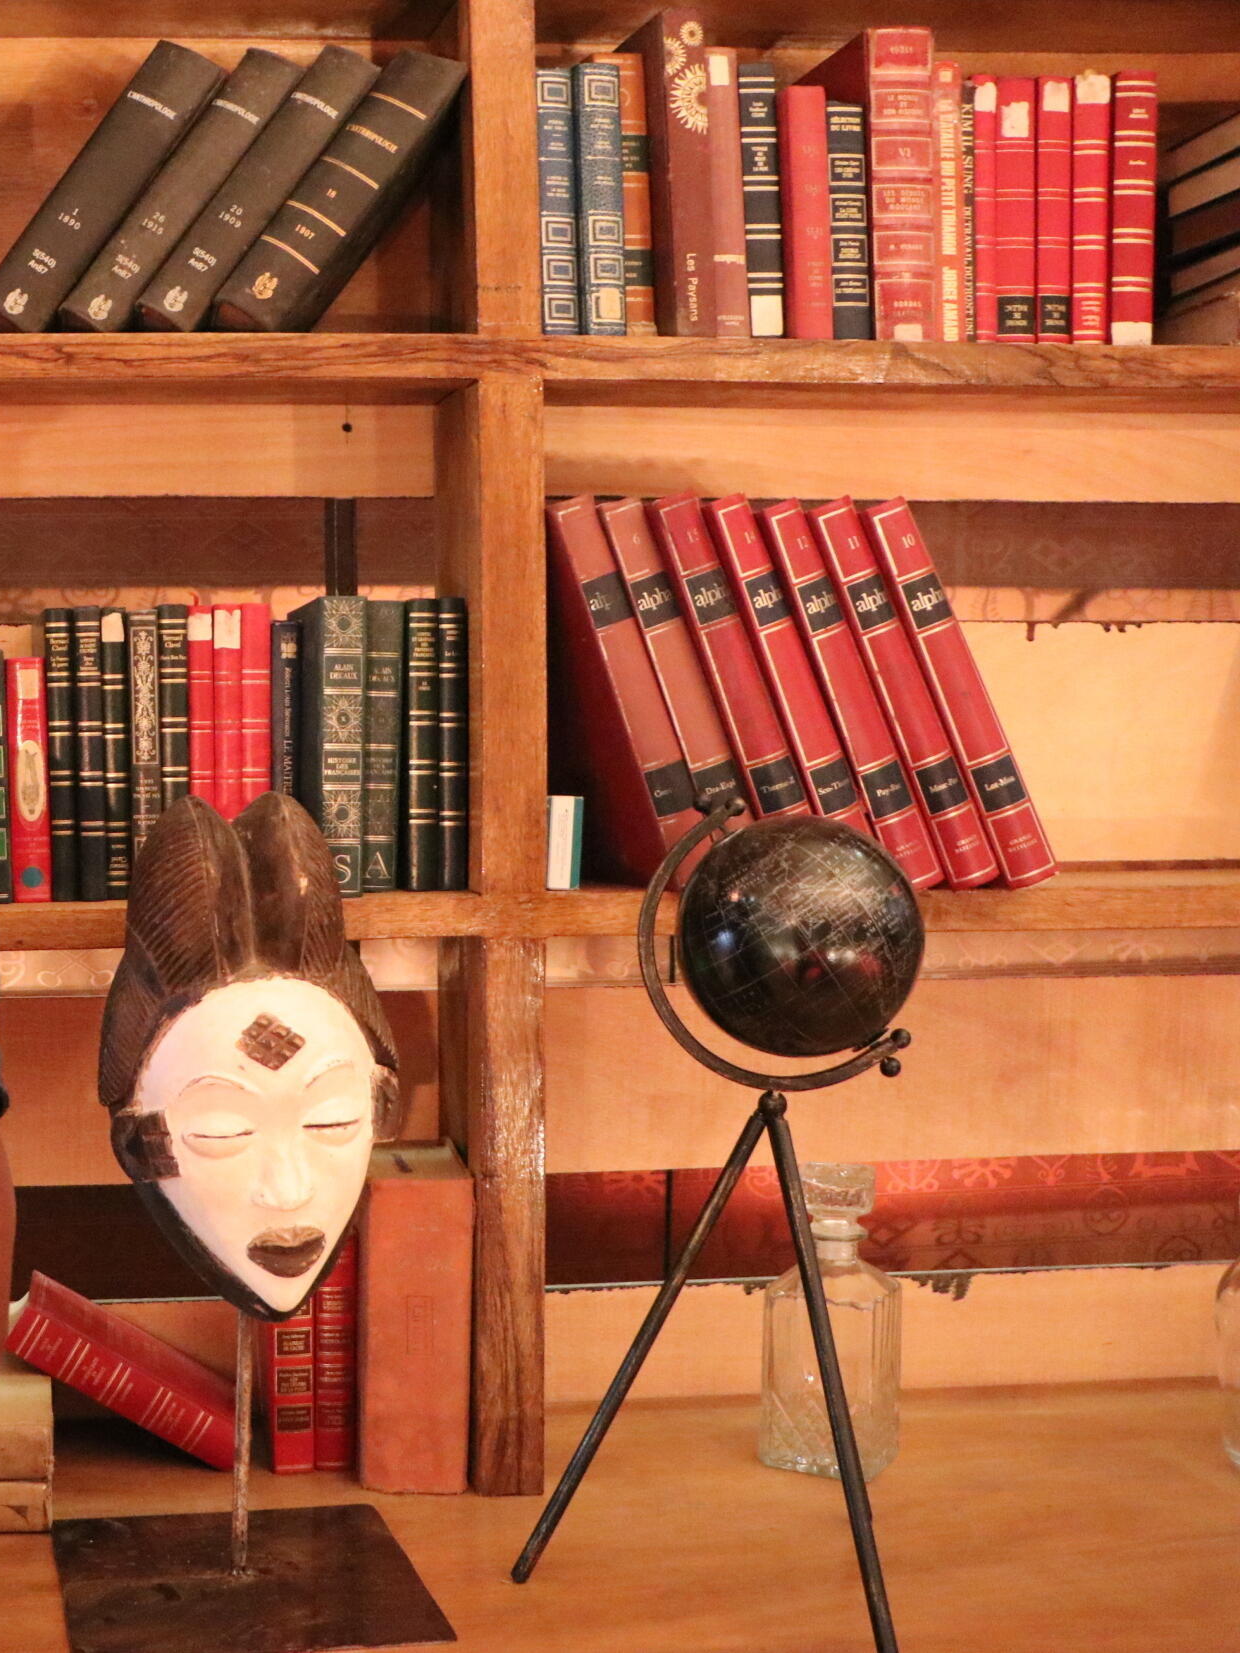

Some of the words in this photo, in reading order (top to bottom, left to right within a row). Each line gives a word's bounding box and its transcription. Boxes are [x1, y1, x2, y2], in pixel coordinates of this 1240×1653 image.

[961, 103, 973, 134] KIM
[963, 156, 973, 194] SUNG
[152, 212, 166, 223] 26
[230, 204, 243, 216] 20
[58, 213, 81, 230] 1890
[142, 218, 164, 235] 1915
[218, 211, 242, 229] 1909
[28, 260, 48, 274] An87
[187, 258, 209, 272] An87
[686, 253, 697, 272] Les
[112, 265, 133, 279] An87
[942, 266, 958, 300] JORGE
[688, 277, 699, 322] Paysans
[943, 302, 959, 341] AMADO
[633, 532, 641, 544] 6
[902, 534, 915, 548] 10
[637, 588, 672, 611] alpha
[694, 583, 728, 608] alph
[856, 588, 886, 613] alph
[329, 672, 358, 680] DECAUX
[283, 740, 294, 752] LE
[334, 854, 351, 884] S
[365, 851, 392, 879] A
